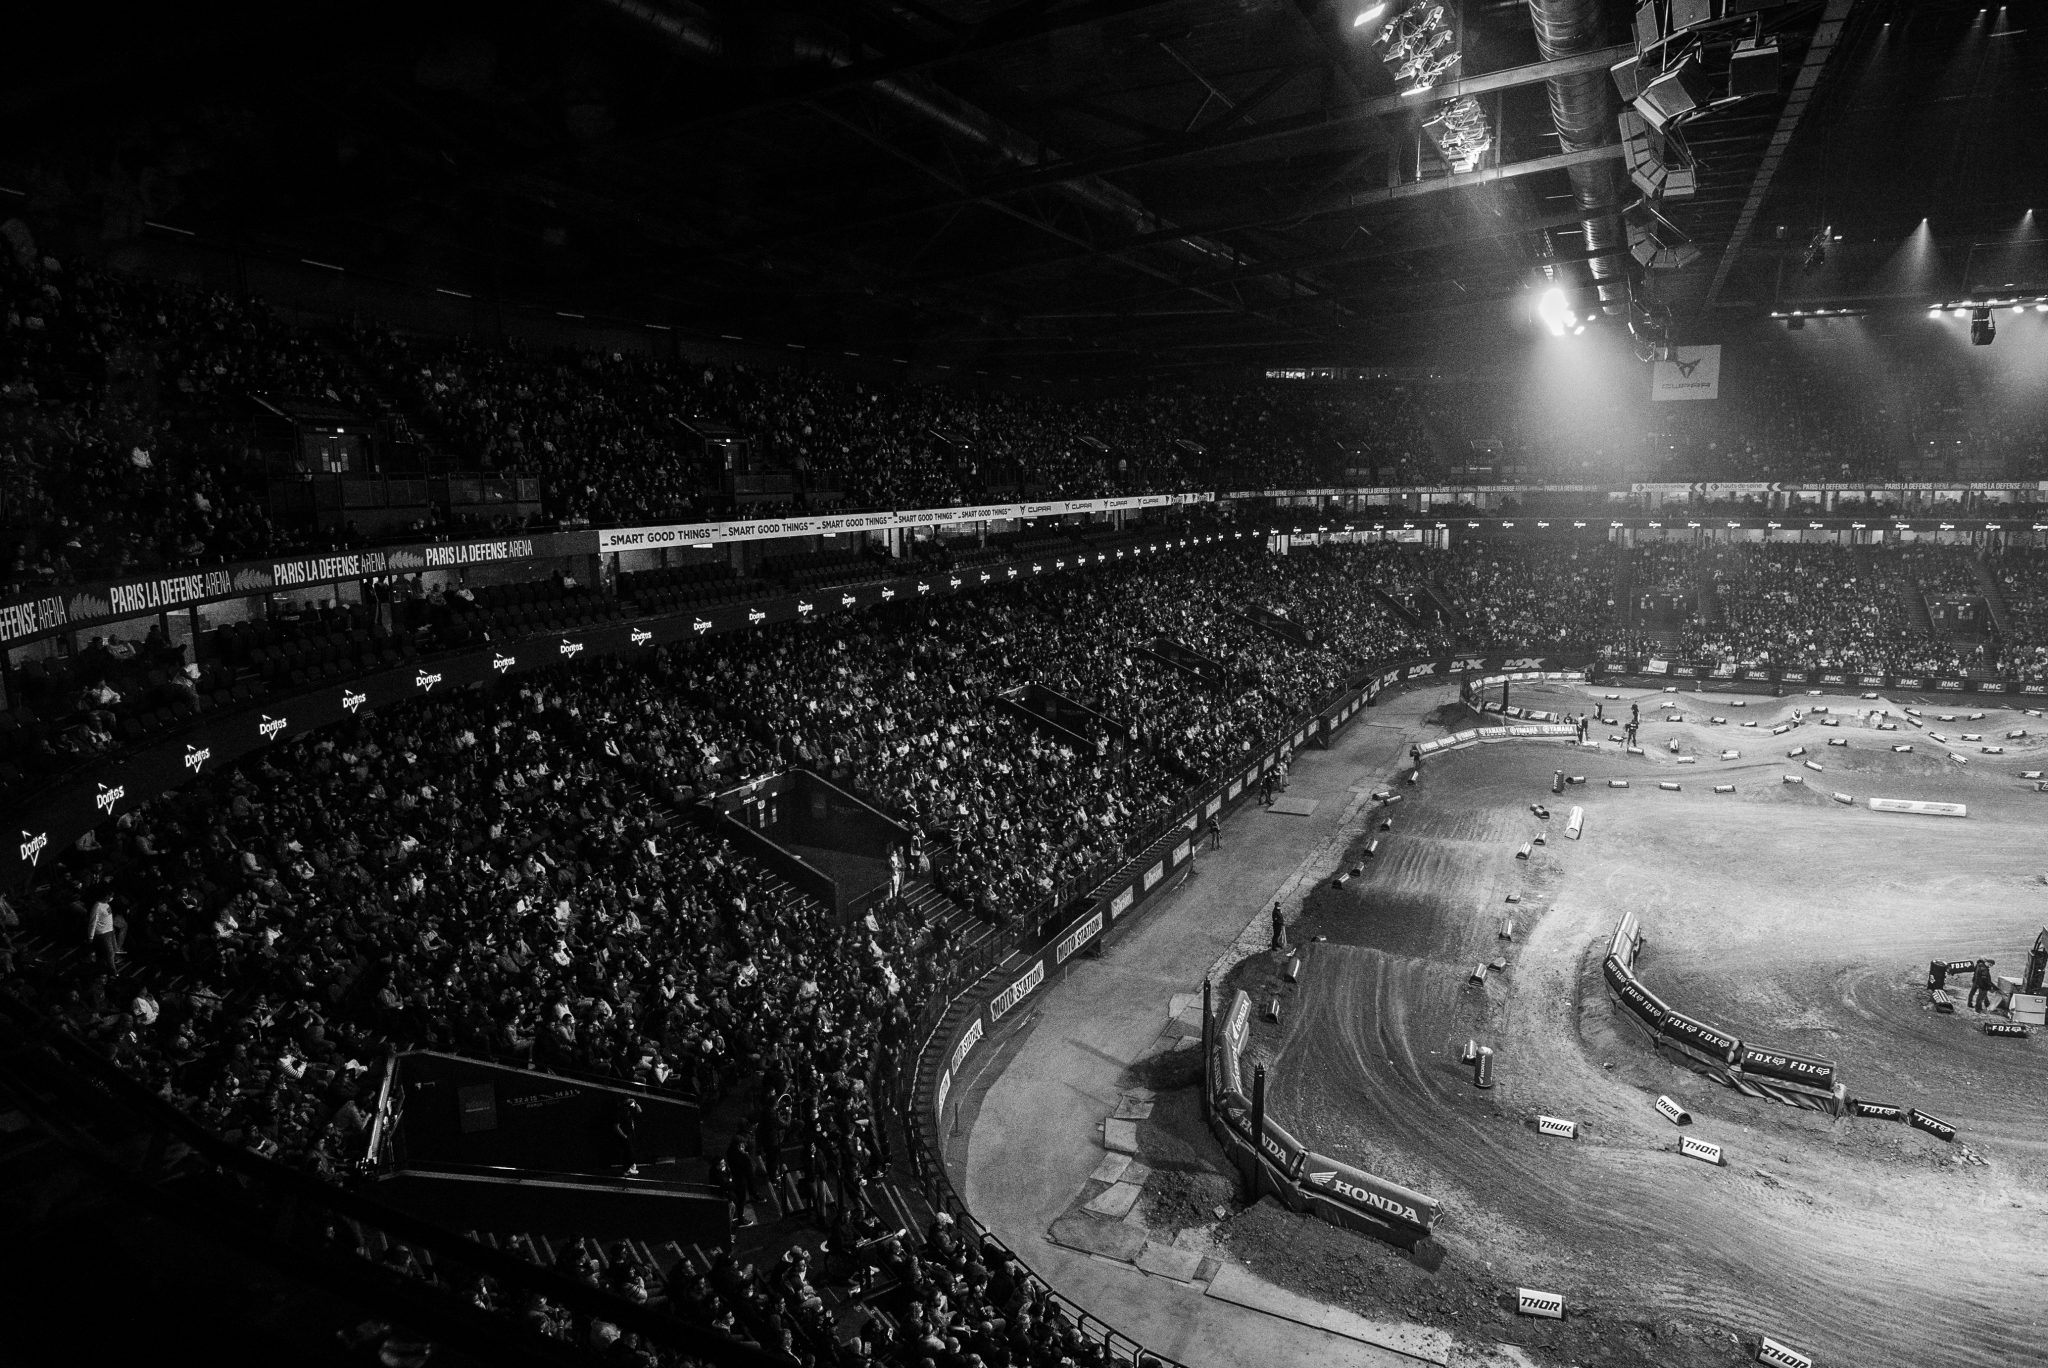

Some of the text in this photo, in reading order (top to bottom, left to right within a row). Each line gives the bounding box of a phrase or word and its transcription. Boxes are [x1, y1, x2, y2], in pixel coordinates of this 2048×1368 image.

[1027, 505, 1051, 513] CUPRA
[1072, 501, 1092, 510] CUPRA
[821, 516, 888, 529] SMART GOOD THINGS
[898, 512, 953, 524] SMART GOOD THINGS
[610, 528, 711, 546] SMART GOOD THINGS
[728, 522, 809, 537] SMART GOOD THINGS
[425, 539, 533, 566] PARIS LA DEFENSE ARENA
[273, 551, 387, 587] PARIS LA DEFENSE ARENA
[110, 569, 232, 614] PARIS LA DEFENSE ARENA
[0, 595, 67, 640] EFENSE ARENA
[560, 643, 583, 654] Doritos
[493, 656, 515, 669] Doritos
[1409, 663, 1437, 676] MX
[1451, 658, 1487, 670] MX
[1505, 658, 1546, 669] MX
[416, 673, 441, 687] Doritos
[1384, 669, 1400, 682] MX
[343, 693, 366, 708] Doritos
[260, 718, 287, 735] Doritos
[1485, 726, 1506, 734] YAMAHA
[1514, 726, 1537, 734] YAMAHA
[1549, 725, 1573, 733] YAMAHA
[185, 747, 211, 767] Doritos
[97, 785, 125, 810] Doritos
[21, 832, 48, 860] Doritos
[1058, 935, 1075, 962] MOTO
[991, 965, 1041, 1020] MOTO STATION
[1625, 986, 1654, 1013] FOX FOX
[1667, 1017, 1719, 1044] FOX FOX
[1991, 1025, 2011, 1033] FOX
[1747, 1051, 1817, 1074] FOX FOX
[1657, 1098, 1680, 1119] THOR
[1863, 1105, 1885, 1115] FOX
[1541, 1120, 1572, 1133] THOR
[1917, 1115, 1940, 1129] FOX
[1239, 1117, 1286, 1165] HNDA
[1685, 1140, 1718, 1157] THOR
[1333, 1180, 1420, 1224] HONDA
[1521, 1296, 1561, 1312] THOR
[1763, 1344, 1809, 1368] THOR
